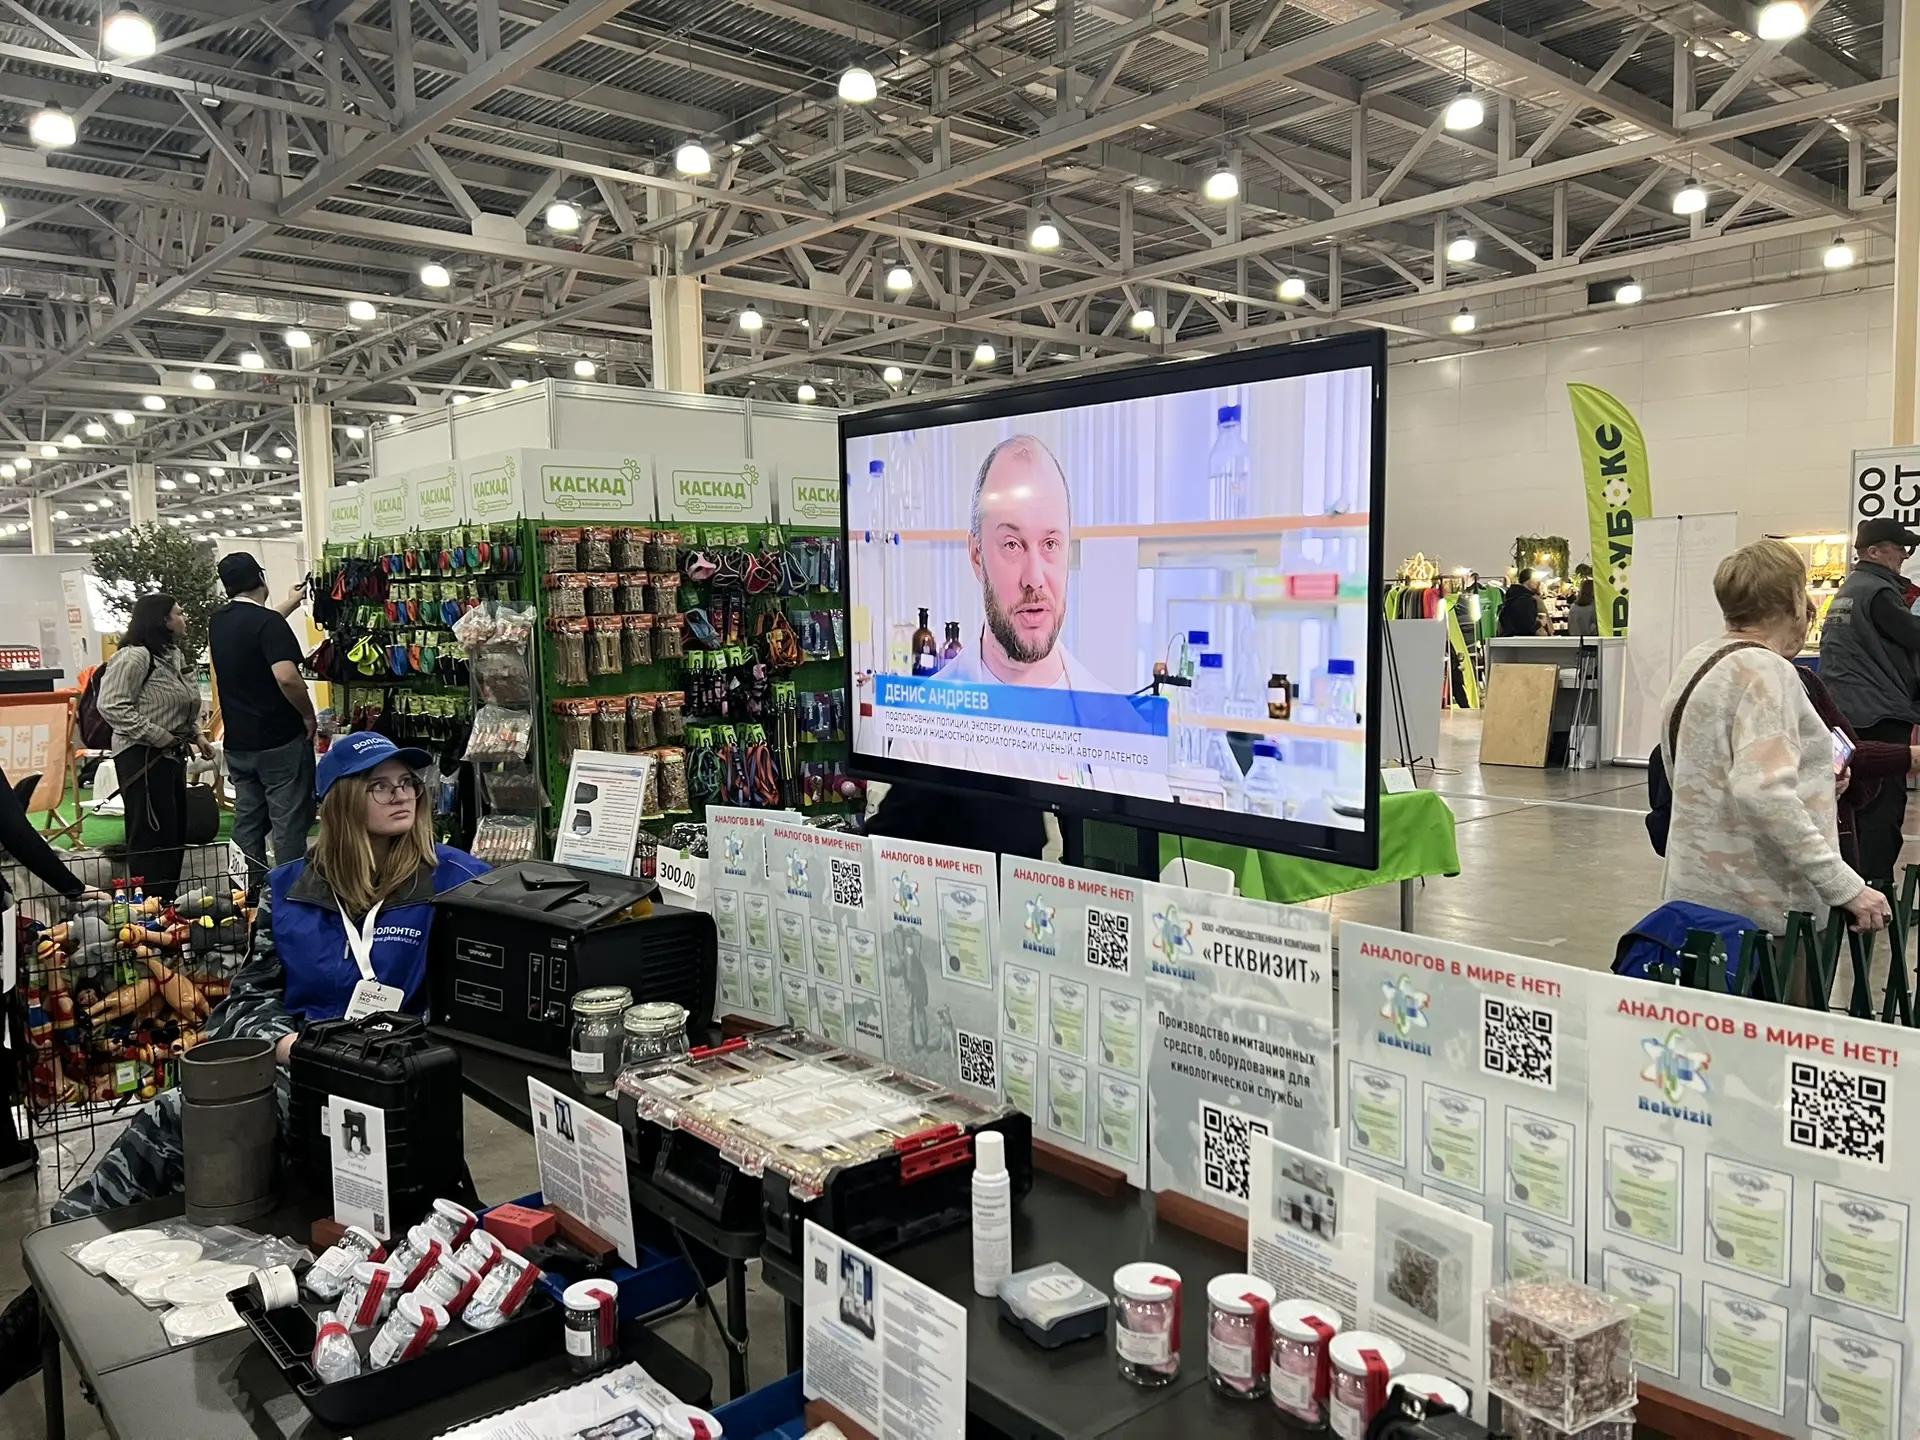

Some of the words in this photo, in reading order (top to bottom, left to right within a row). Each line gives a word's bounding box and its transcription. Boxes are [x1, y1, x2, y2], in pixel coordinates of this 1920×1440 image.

[419, 486, 450, 504] КАСКАД
[472, 477, 509, 498] КАСКАД
[549, 475, 626, 496] КАСКАД
[679, 479, 746, 499] КАСКАД
[332, 505, 358, 521] КАСКАД
[373, 497, 403, 513] КАСКАД
[885, 683, 926, 704] ДЕНИС
[928, 688, 989, 710] АНДРЕЕВ
[885, 711, 935, 725] ПОДПОЛКОВНИК
[937, 717, 970, 730] ПОЛИЦИИ,
[972, 720, 1030, 736] ЭКСПЕРТ-ХИМИК,
[1031, 728, 1081, 742] СПЕЦИАЛИСТ
[885, 723, 894, 732] ПО
[895, 723, 922, 736] ГАЗОВОЙ
[929, 728, 974, 743] ЖИДКОСТНОЙ
[976, 734, 1040, 752] ХРОМАТОГРАФИИ,
[1077, 747, 1103, 759] АВТОР
[1104, 750, 1149, 765] ПАТЕНТОВ
[714, 815, 749, 826] АНАЛОГОВ
[750, 817, 755, 826] В
[774, 828, 813, 843] АНАЛОГОВ
[814, 836, 820, 844] В
[821, 837, 843, 849] МИРЕ
[844, 842, 862, 853] НЕТ!
[660, 862, 696, 889] 300,00
[880, 849, 925, 865] АНАЛОГОВ
[927, 858, 933, 866] В
[935, 859, 960, 872] МИРЕ
[962, 863, 982, 876] НЕТ!
[1013, 868, 1065, 888] АНАЛОГОВ
[1068, 878, 1074, 889] В
[1077, 881, 1107, 897] МИРЕ
[1110, 889, 1134, 903] НЕТ!
[1203, 942, 1320, 984] «РЕКВИЗИТ»
[1360, 942, 1445, 972] АНАЛОГОВ
[1451, 961, 1461, 975] В
[1467, 964, 1516, 988] МИРЕ
[1521, 977, 1561, 998] НЕТ!
[1158, 1011, 1230, 1042] Производство
[1232, 1034, 1316, 1066] имитационных
[1378, 1031, 1432, 1056] Rekvizit
[1618, 999, 1735, 1034] АНАЛОГОВ
[1743, 1022, 1758, 1039] В
[1767, 1026, 1835, 1055] МИРЕ
[1843, 1041, 1898, 1067] НЕТ!
[1163, 1036, 1207, 1060] средств,
[1209, 1048, 1286, 1081] оборудования
[1288, 1073, 1311, 1089] для
[1171, 1060, 1254, 1094] кинологической
[1257, 1085, 1303, 1109] службы
[1638, 1095, 1713, 1126] Rekvizit
